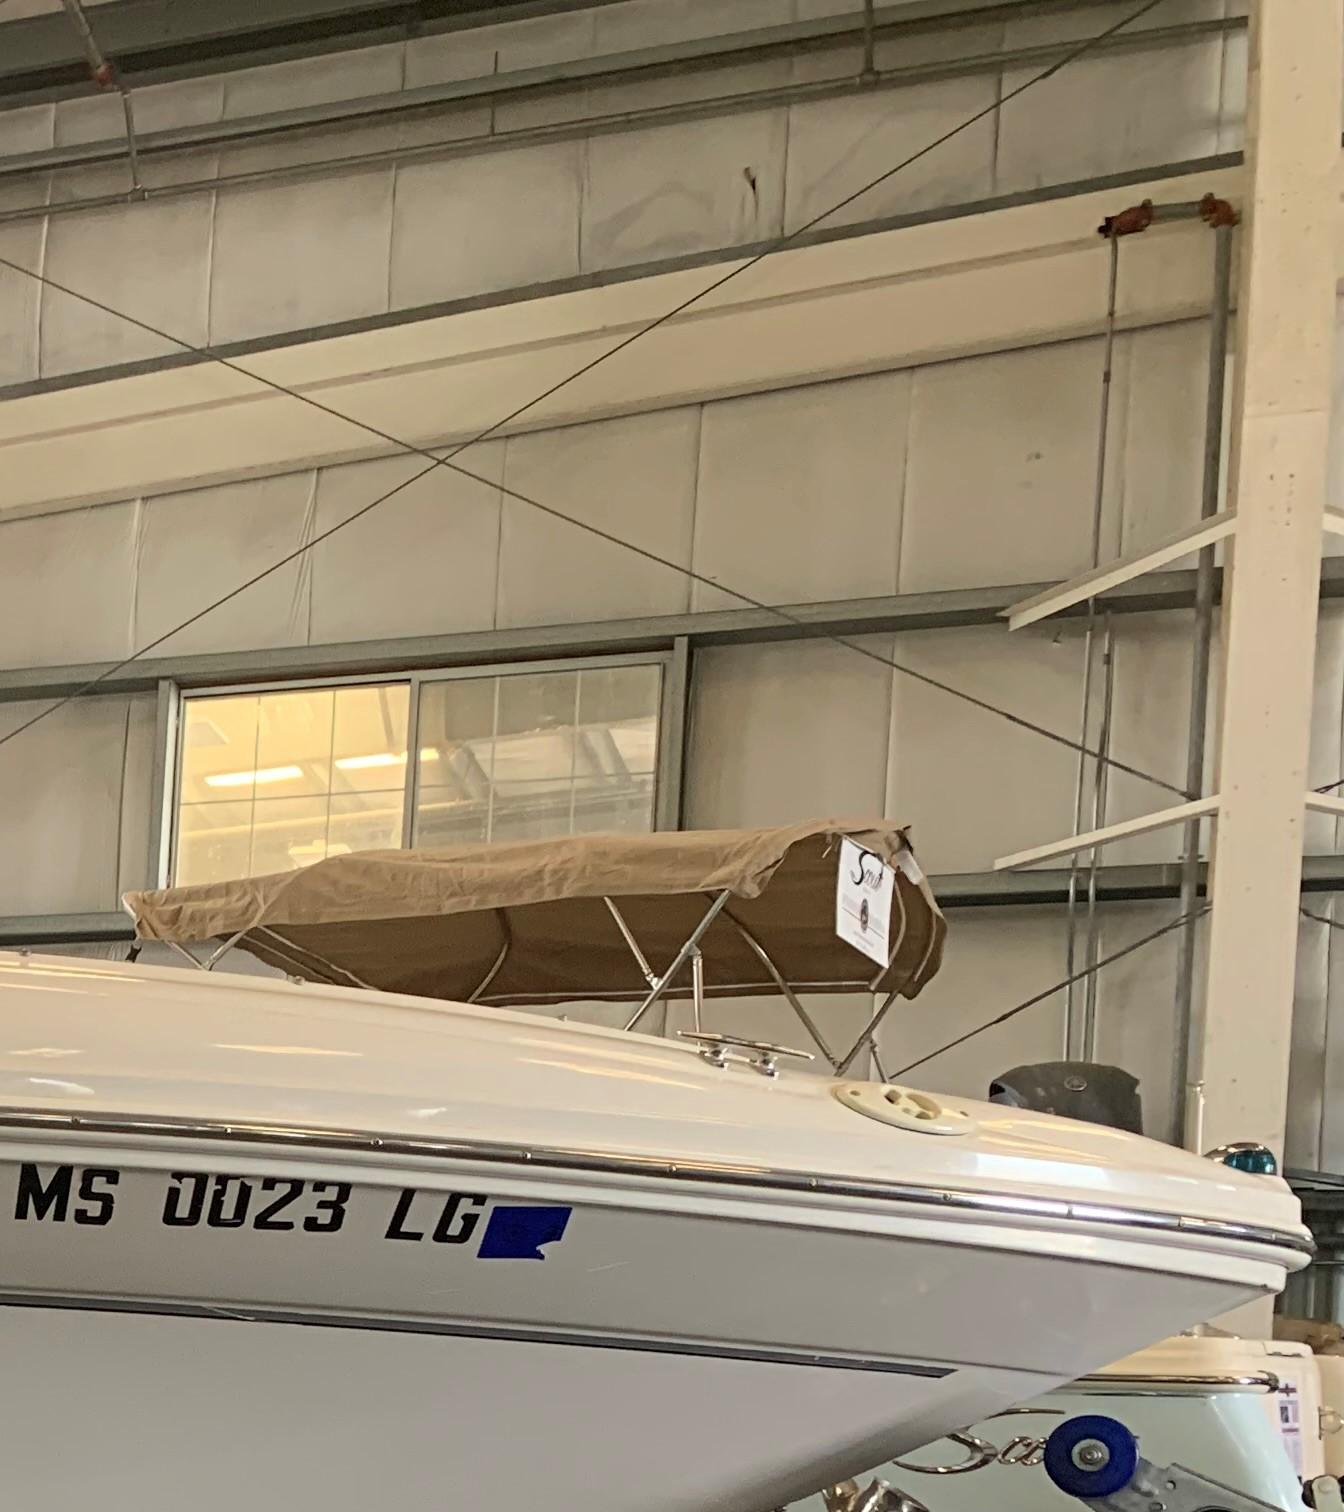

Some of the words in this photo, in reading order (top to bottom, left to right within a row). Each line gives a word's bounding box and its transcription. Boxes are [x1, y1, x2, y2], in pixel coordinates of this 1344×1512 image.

[15, 1163, 120, 1226] MS
[162, 1171, 353, 1233] 0023
[384, 1188, 489, 1244] LG
